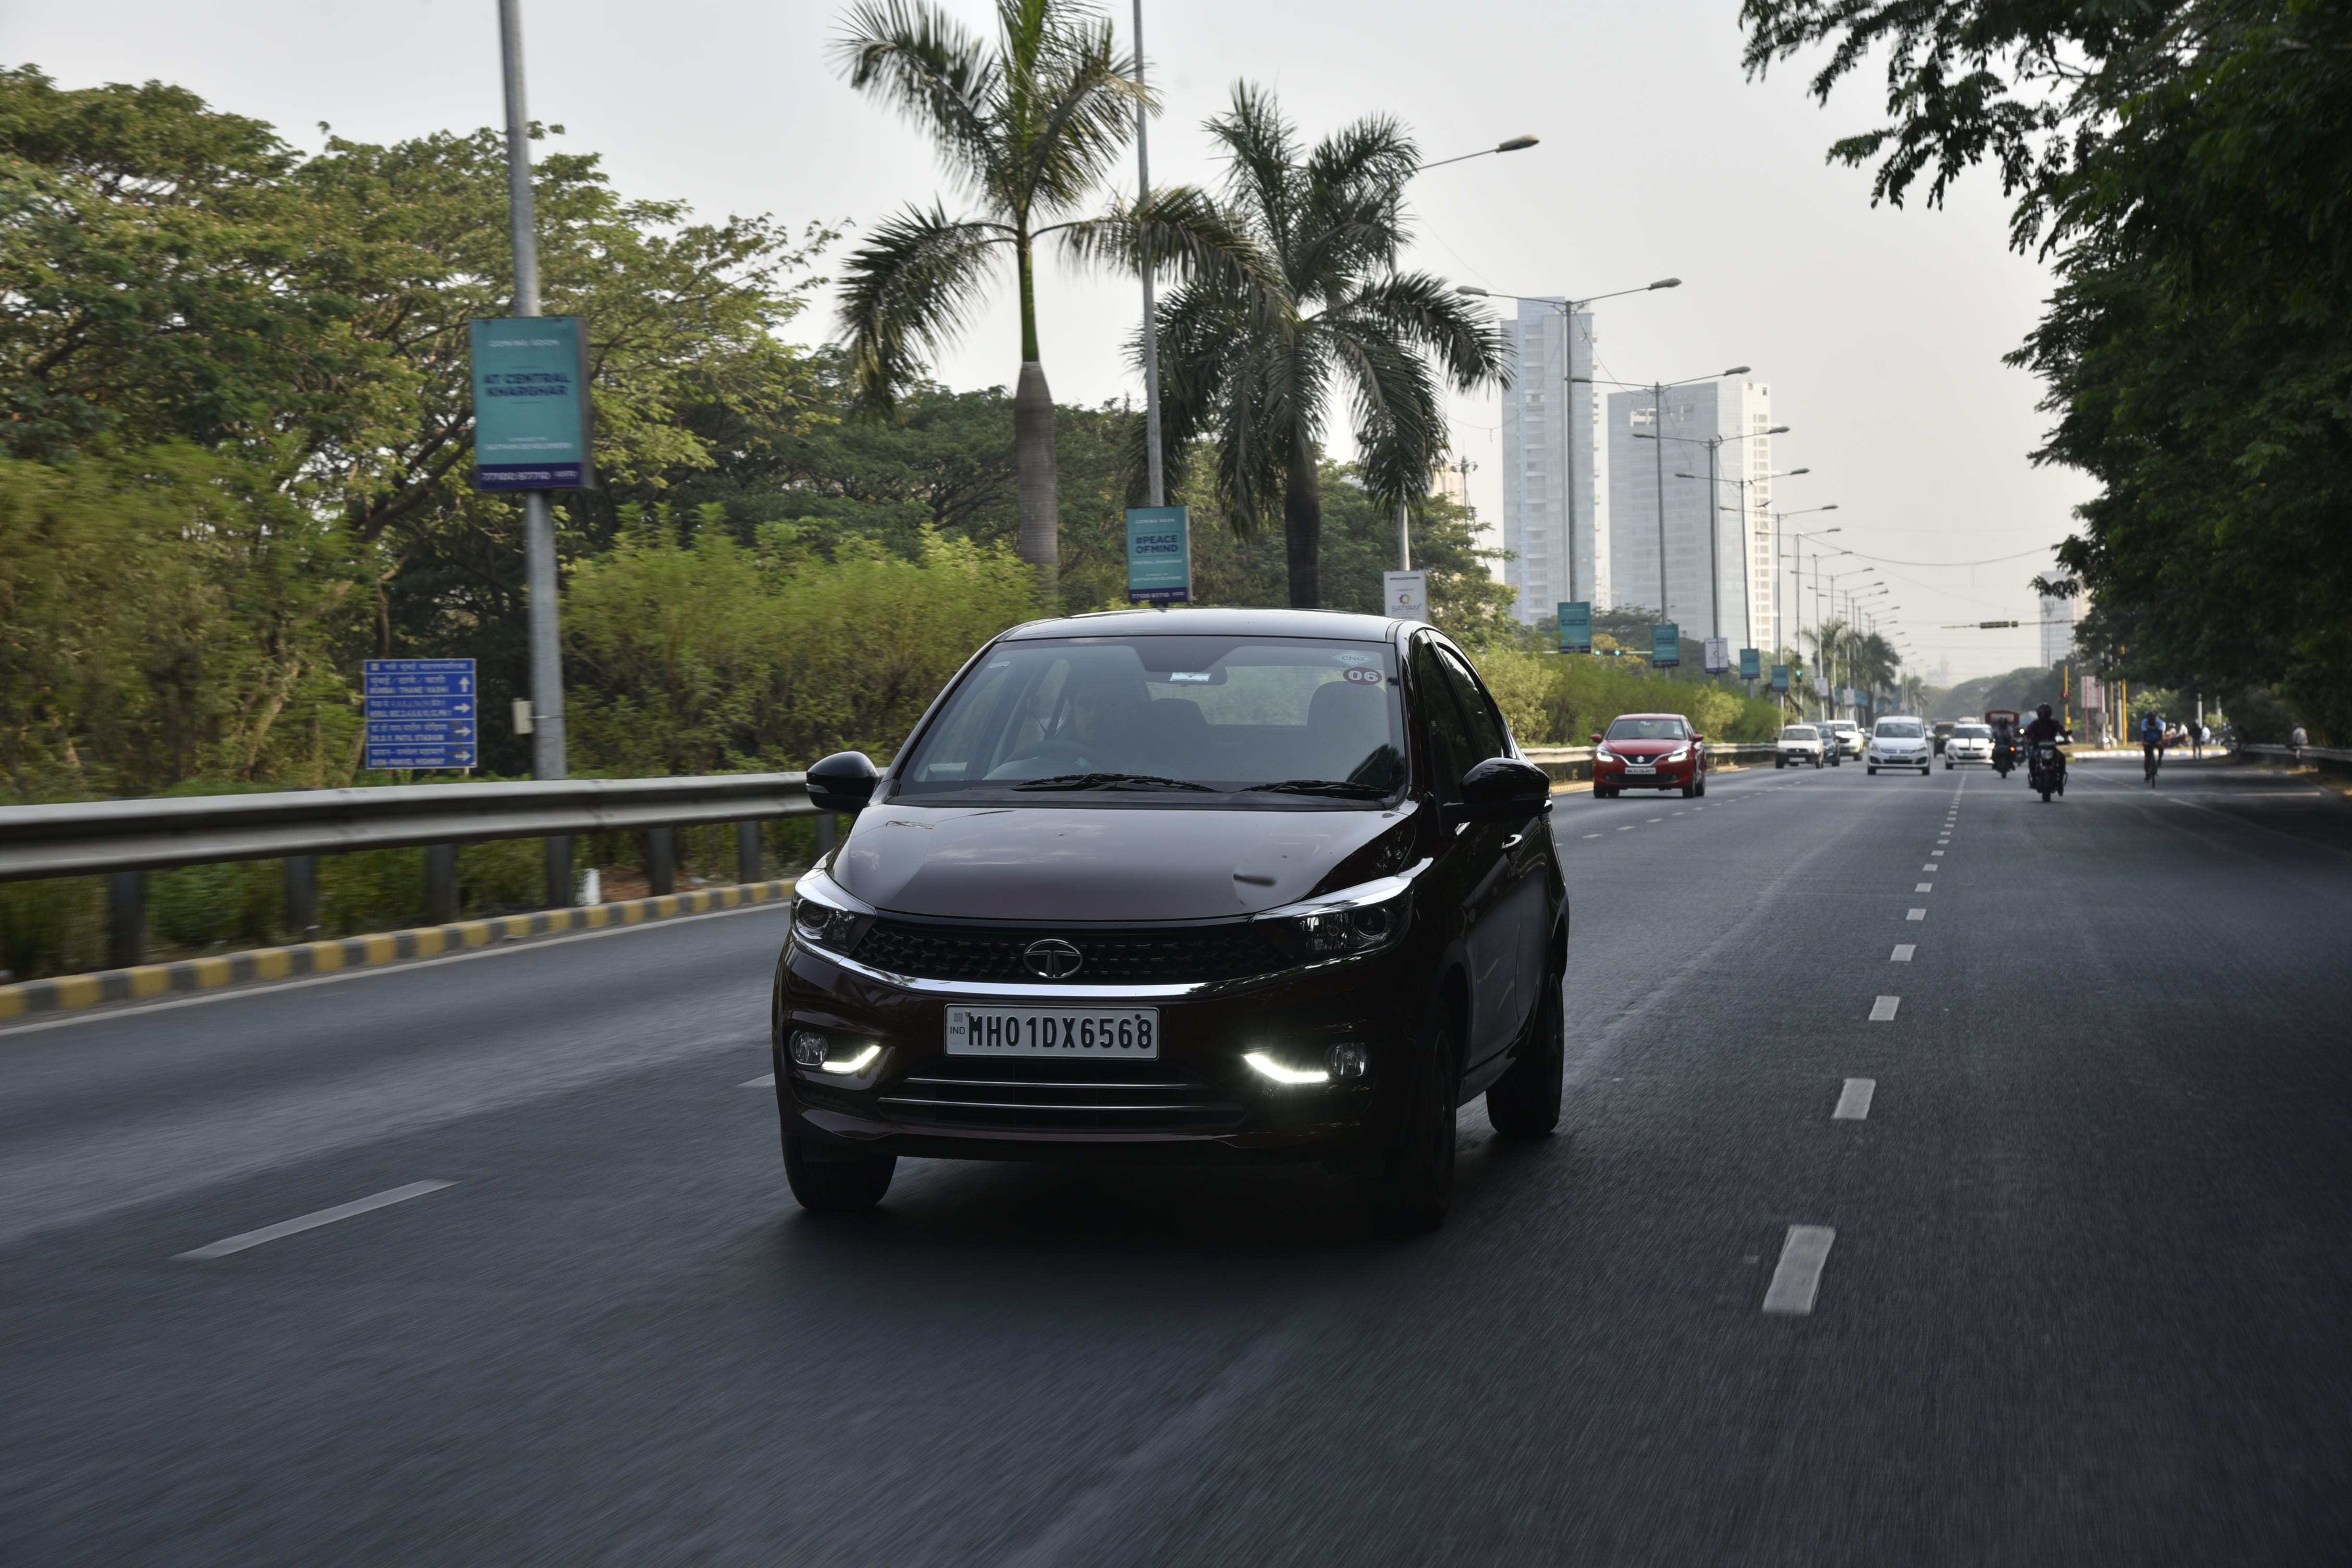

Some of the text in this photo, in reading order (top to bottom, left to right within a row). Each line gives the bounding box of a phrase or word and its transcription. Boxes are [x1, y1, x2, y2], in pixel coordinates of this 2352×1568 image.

[1135, 535, 1178, 544] #PEACE
[1135, 544, 1179, 554] OFMIND
[1348, 670, 1378, 682] 06
[950, 1015, 1152, 1049] IND MH01DX6568
